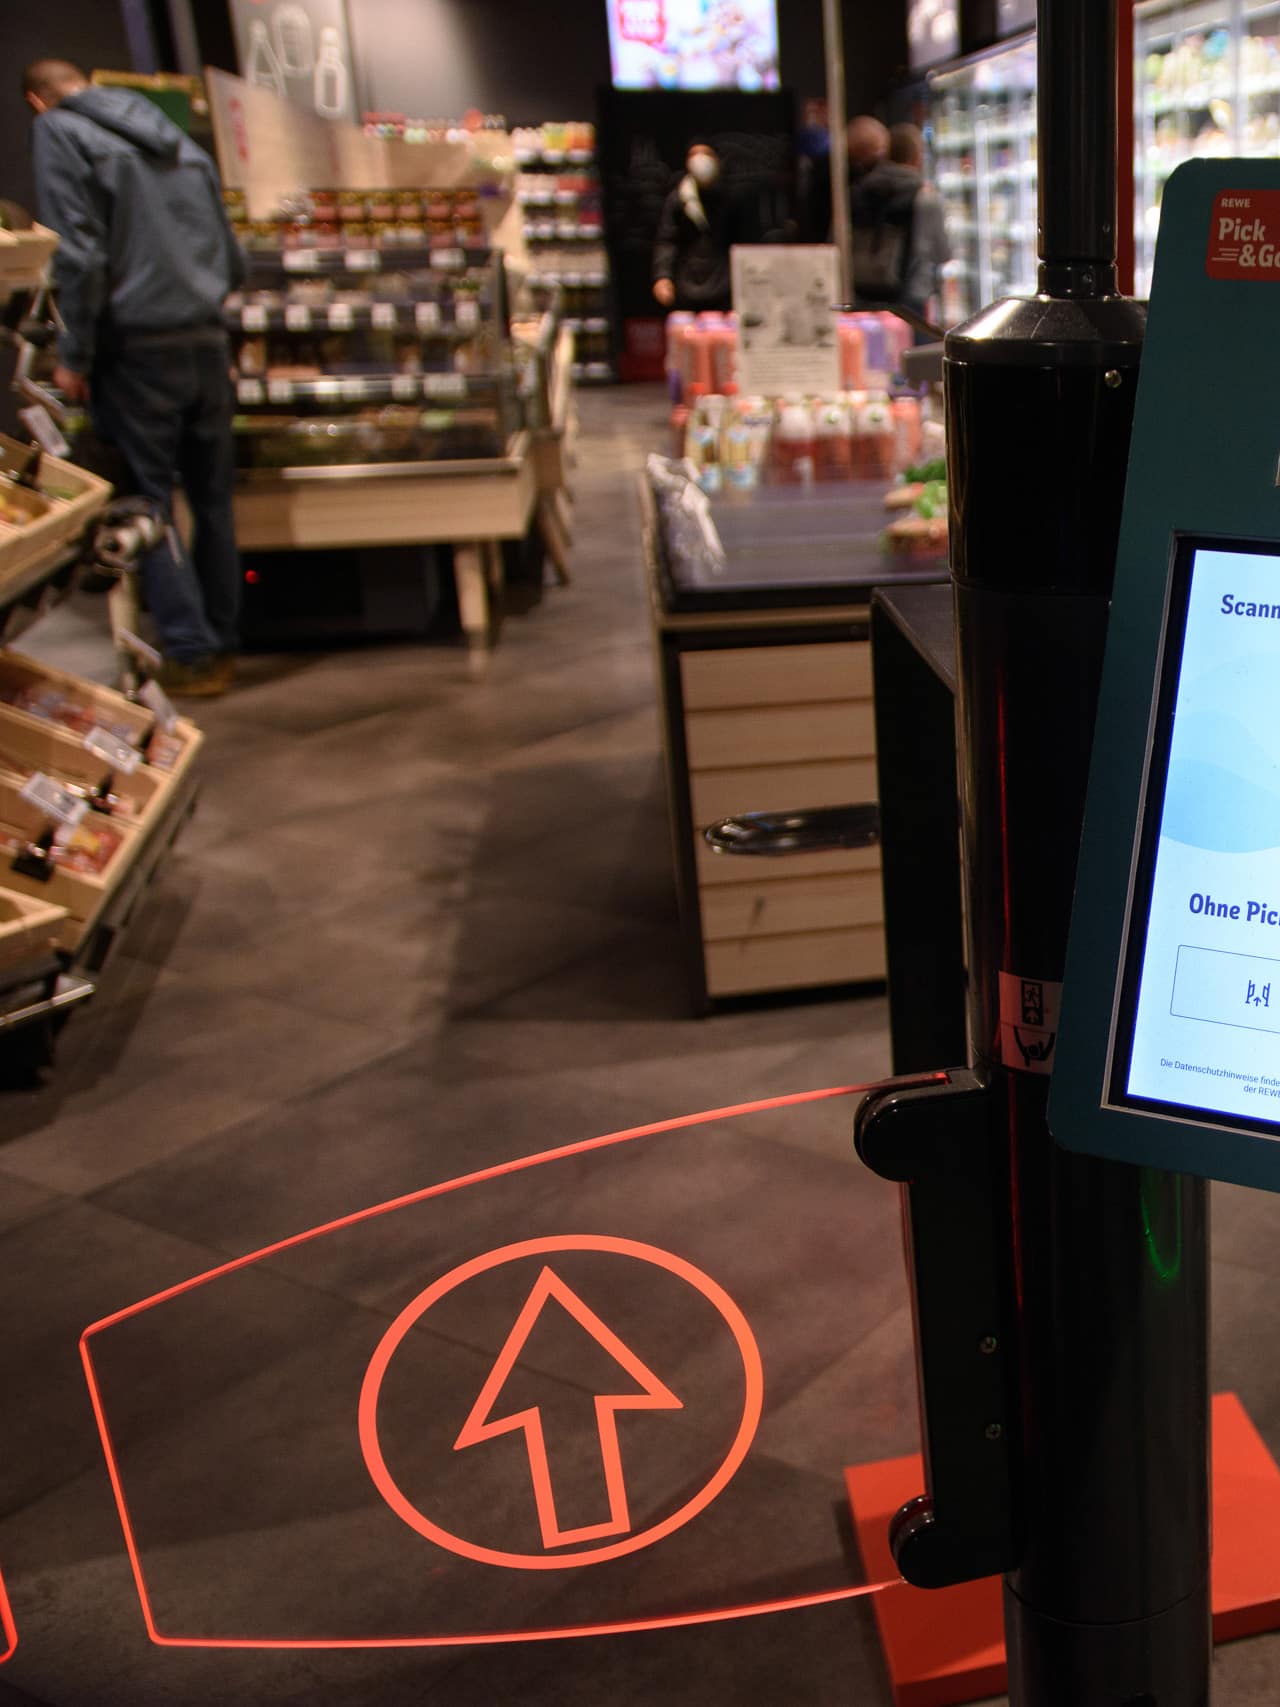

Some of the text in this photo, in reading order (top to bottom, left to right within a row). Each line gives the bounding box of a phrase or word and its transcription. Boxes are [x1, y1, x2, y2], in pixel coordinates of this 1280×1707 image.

[1221, 198, 1251, 208] REWE
[1219, 217, 1266, 241] Pick
[1188, 893, 1241, 920] Ohne
[1160, 1058, 1173, 1068] Die
[1174, 1060, 1259, 1083] Datenschutzhinweise
[1243, 1084, 1257, 1094] der
